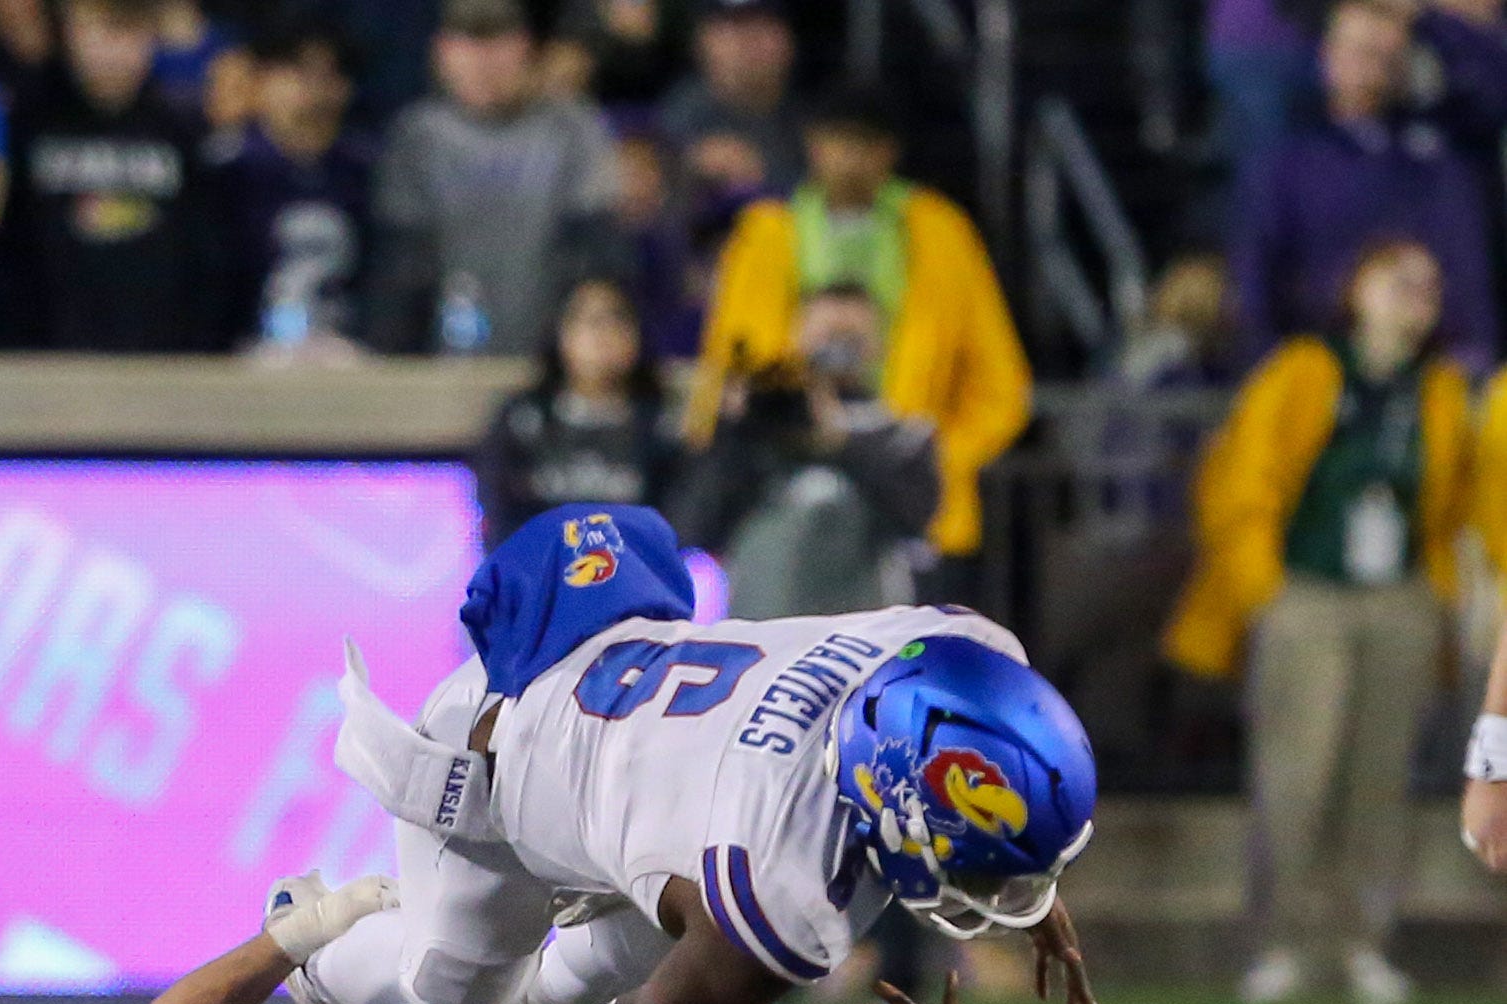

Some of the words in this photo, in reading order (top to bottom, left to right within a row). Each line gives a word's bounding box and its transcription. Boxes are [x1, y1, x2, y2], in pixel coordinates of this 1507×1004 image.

[572, 638, 767, 721] 6
[738, 633, 885, 756] DANIELS
[435, 757, 472, 828] KANSAS
